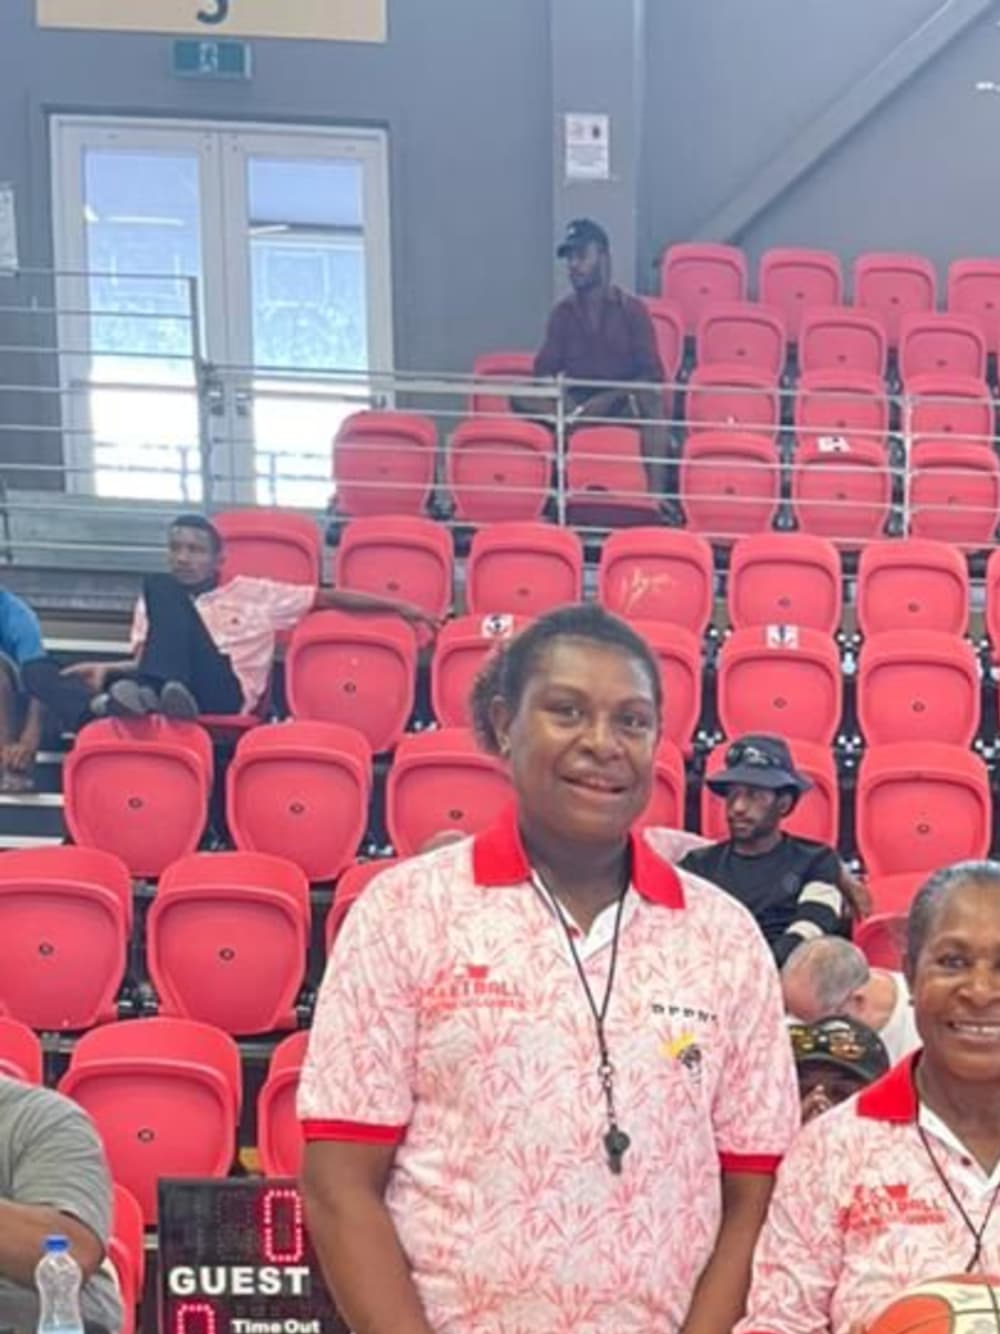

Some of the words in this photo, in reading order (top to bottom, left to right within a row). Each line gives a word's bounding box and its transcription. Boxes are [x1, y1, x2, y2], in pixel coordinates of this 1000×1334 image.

[262, 1188, 304, 1263] 0
[168, 1266, 310, 1295] GUEST
[231, 1319, 282, 1334] Time
[284, 1319, 321, 1334] Out
